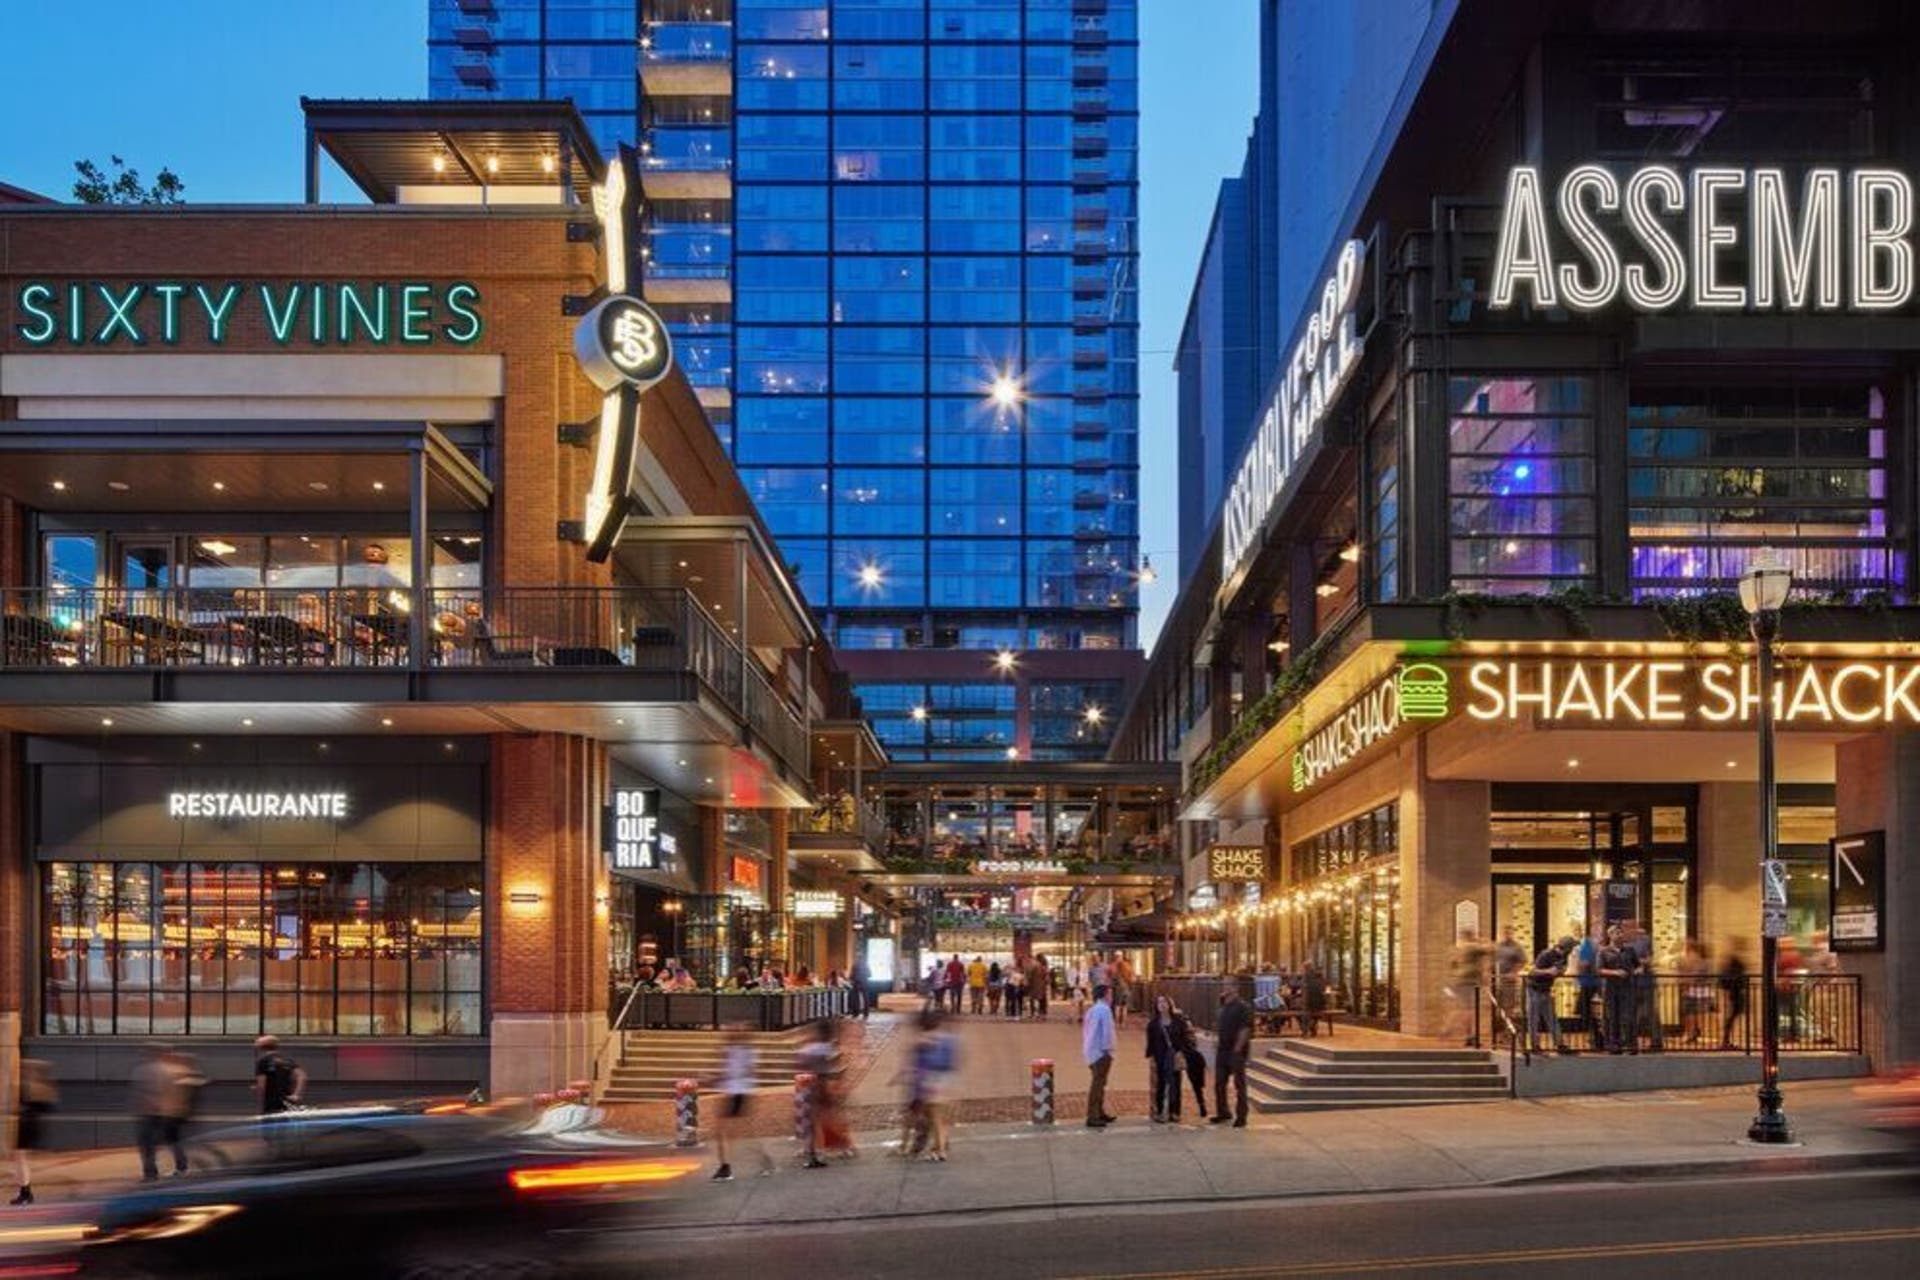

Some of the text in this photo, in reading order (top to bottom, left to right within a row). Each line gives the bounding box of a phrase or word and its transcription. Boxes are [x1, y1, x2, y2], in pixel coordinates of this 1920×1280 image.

[1489, 165, 1916, 310] ASSEMB
[18, 283, 483, 346] SIXTY VINES
[1465, 660, 1686, 721] SHAKE
[1304, 714, 1348, 786] SHAKE
[169, 792, 348, 817] RESTAURANTE
[616, 791, 645, 816] BO
[616, 816, 657, 842] QUE
[616, 842, 652, 867] RIA
[1211, 848, 1263, 864] SHAKE
[1212, 864, 1264, 878] SHACK
